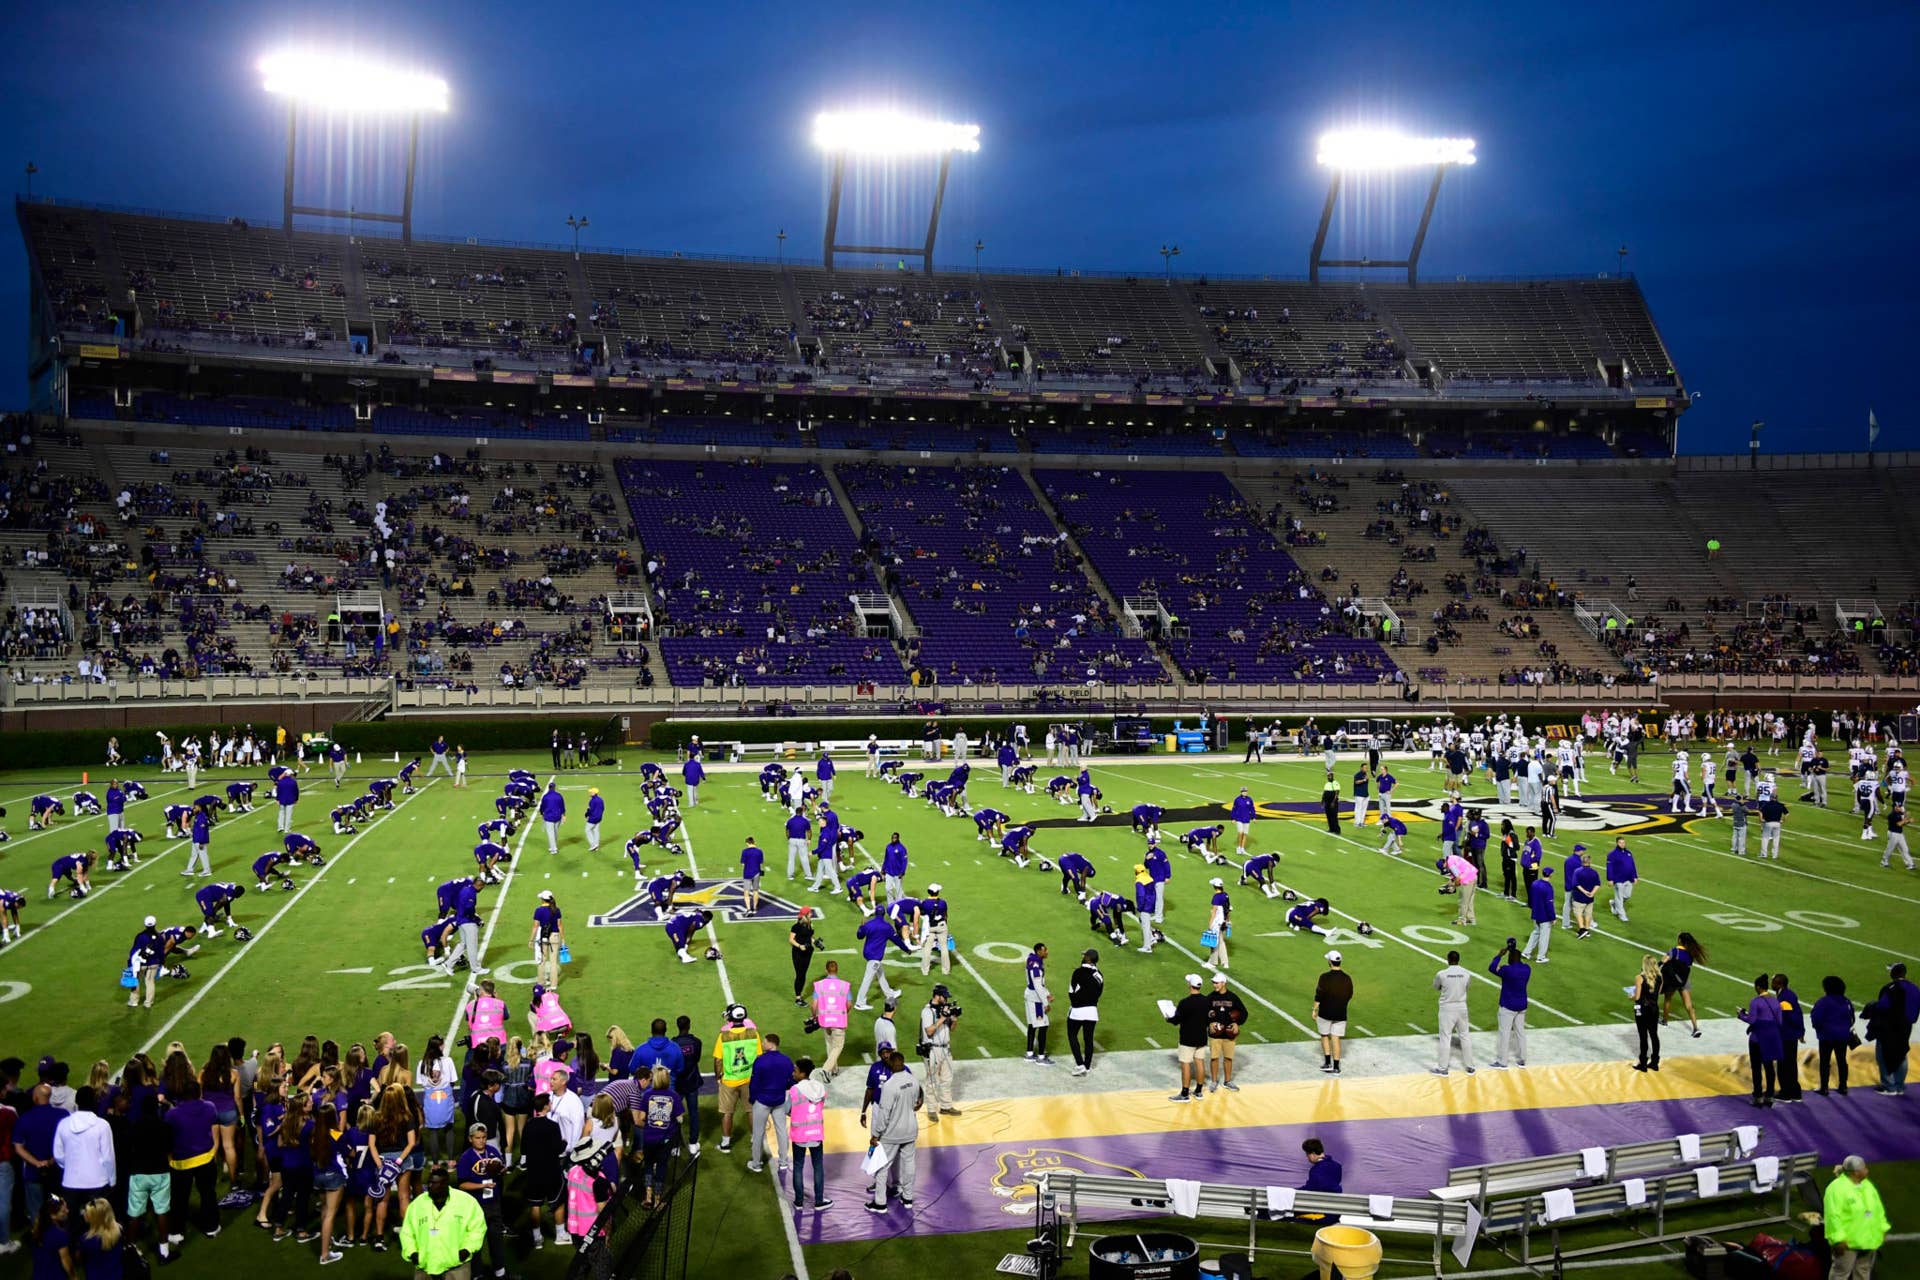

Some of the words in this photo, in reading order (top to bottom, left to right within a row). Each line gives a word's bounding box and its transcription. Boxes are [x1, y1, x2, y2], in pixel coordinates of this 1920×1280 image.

[1561, 752, 1570, 762] 11
[1701, 909, 1861, 932] 50
[1321, 924, 1470, 949] 40
[377, 960, 560, 991] 20
[355, 1145, 369, 1169] 7
[1016, 1156, 1061, 1169] ECU
